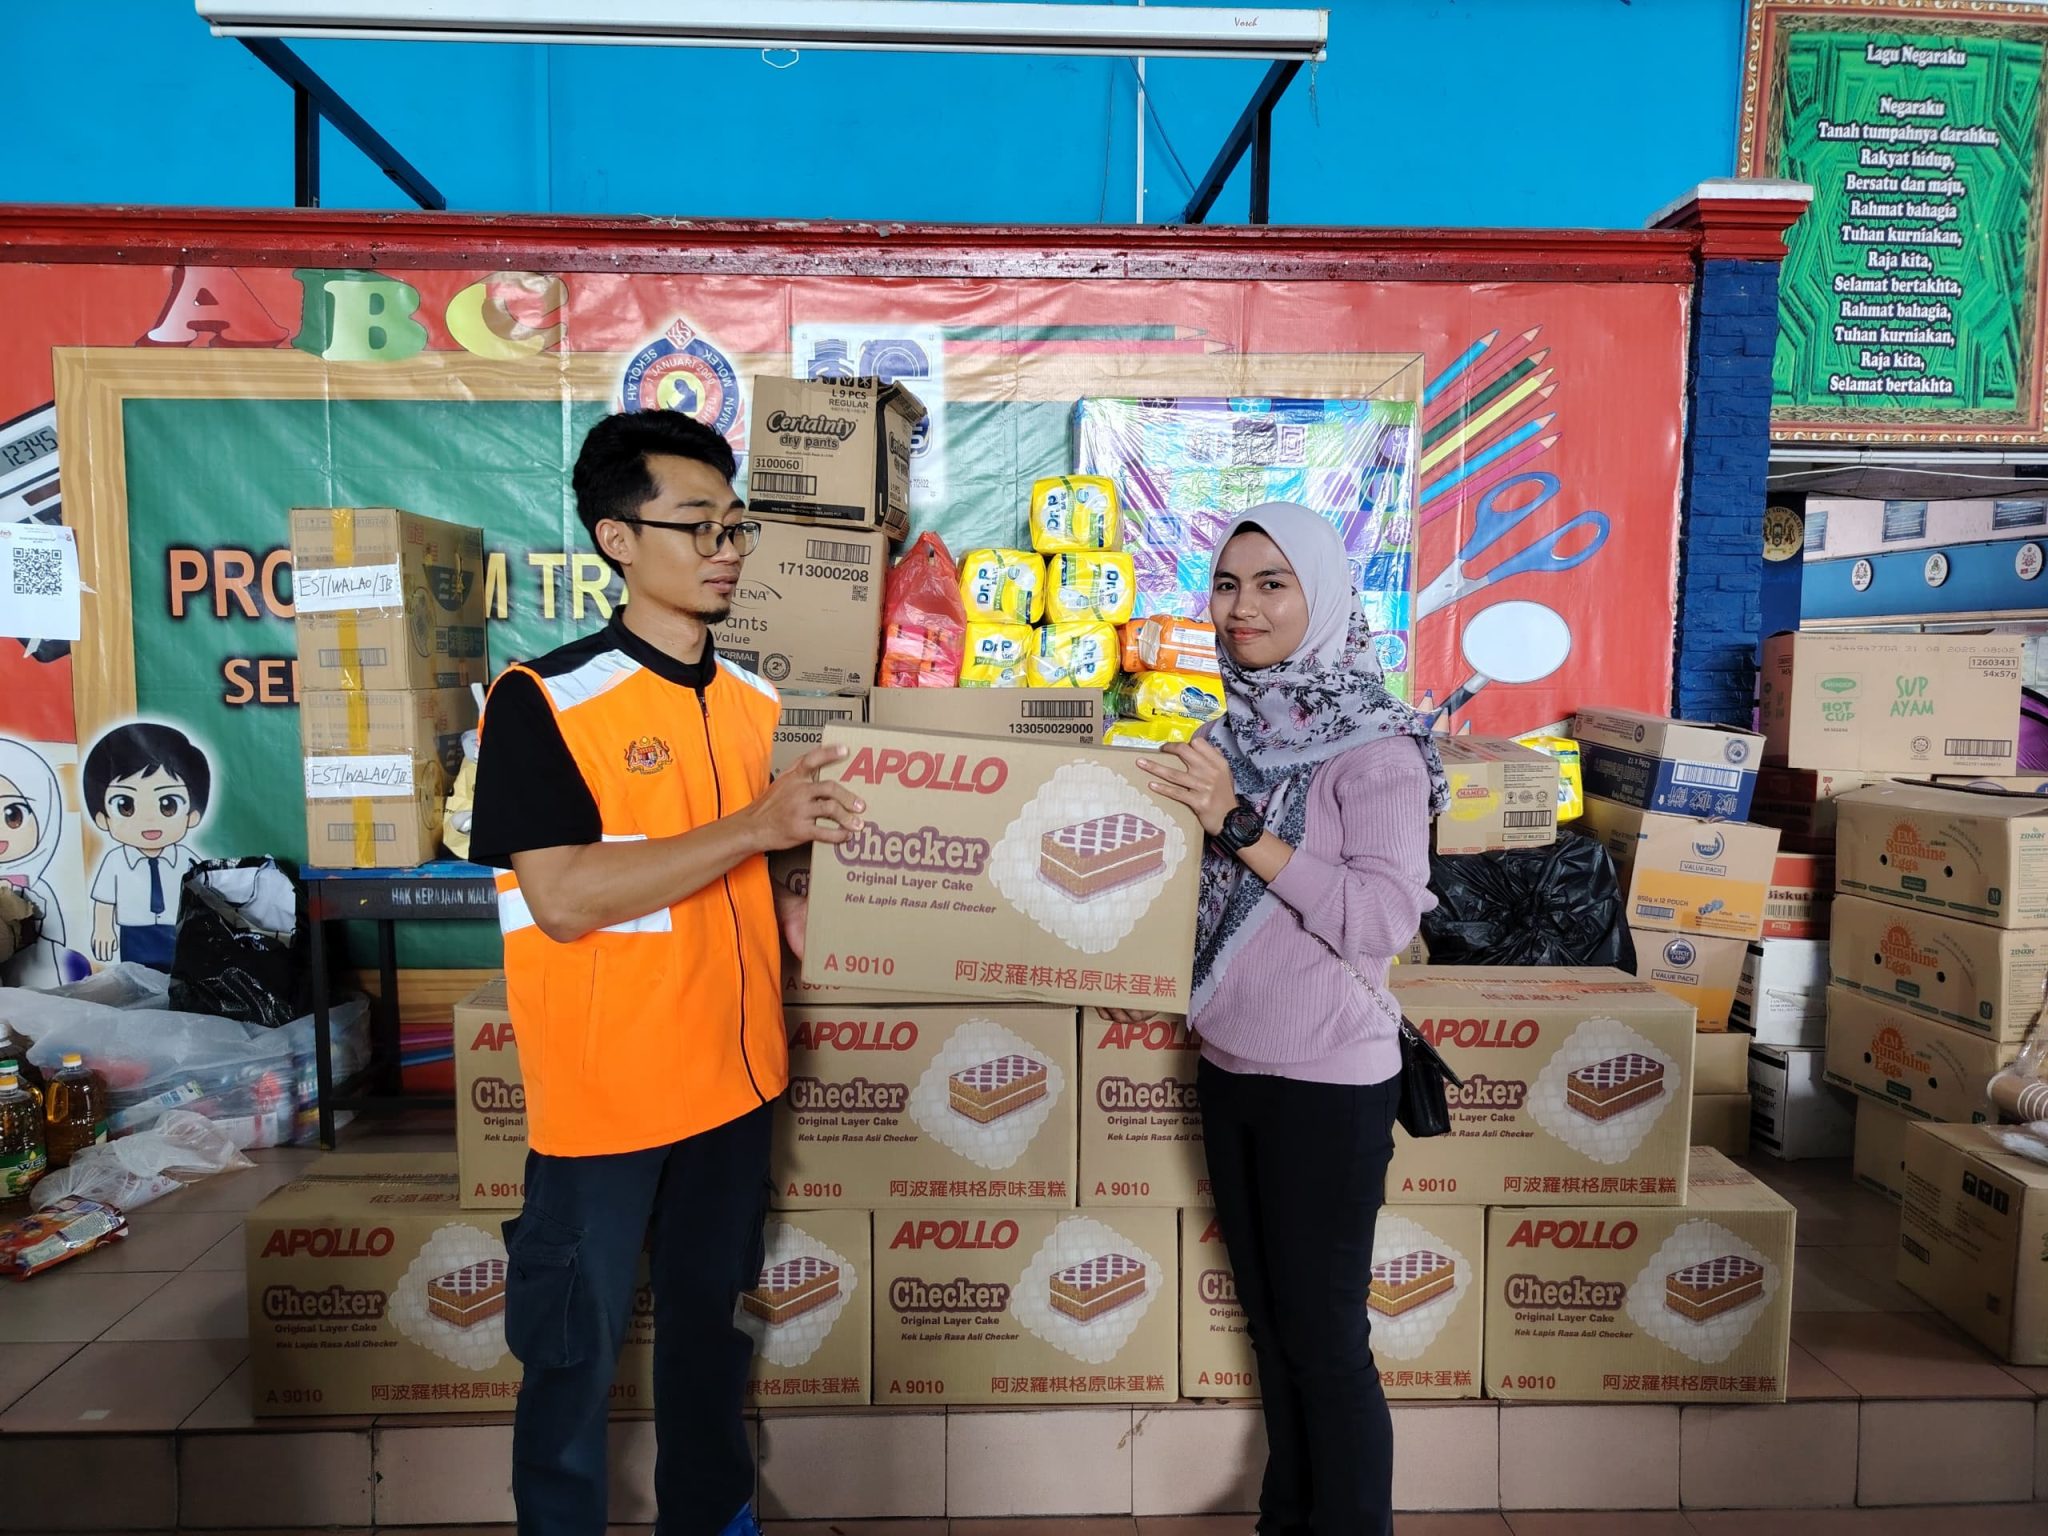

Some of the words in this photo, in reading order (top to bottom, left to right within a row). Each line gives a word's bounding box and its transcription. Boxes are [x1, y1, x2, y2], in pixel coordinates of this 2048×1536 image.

[1867, 45, 1899, 65] Lagu
[1902, 46, 1966, 67] Negaraku
[1880, 98, 1945, 118] Negaraku
[1818, 121, 1860, 138] Tanah
[1863, 125, 1937, 144] tumpahnya
[1940, 128, 1999, 147] darahku,
[1860, 149, 1910, 168] Rakyat
[1912, 151, 1955, 170] hidup,
[1847, 174, 1897, 191] Bersatu
[1900, 176, 1926, 191] dan
[1928, 178, 1966, 196] maju,
[1851, 200, 1904, 217] Rahmat
[1906, 201, 1957, 220] bahagia
[1842, 225, 1884, 241] Tuhan
[1887, 227, 1962, 246] kurniakan,
[1868, 251, 1898, 270] Raja
[1901, 252, 1932, 271] kita,
[1834, 276, 1889, 292] Selamat
[1891, 277, 1962, 297] bertakhta,
[1841, 302, 1894, 317] Rahmat
[1897, 303, 1951, 321] bahagia,
[1834, 326, 1877, 342] Tuhan
[1880, 328, 1955, 346] kurniakan,
[703, 349, 733, 388] MOLEK
[1861, 352, 1890, 371] Raja
[1893, 353, 1925, 371] kita,
[627, 349, 657, 401] SEKOLAH
[651, 358, 696, 377] JANUARI
[697, 364, 716, 385] 2000
[1829, 376, 1884, 392] Selamat
[1886, 377, 1953, 393] bertakhta
[829, 399, 869, 409] REGULAR
[840, 390, 846, 399] 9
[848, 390, 867, 400] PCS
[767, 410, 856, 442] Certainty
[0, 430, 58, 467] 12345
[780, 433, 801, 449] dry
[804, 436, 839, 450] pants
[755, 458, 800, 470] 3100060
[778, 561, 869, 582] 1713000208
[714, 616, 768, 632] ants
[715, 632, 751, 644] Value
[1947, 646, 1976, 654] 2025
[1972, 659, 2016, 668] 12603431
[1983, 670, 2017, 679] 54x57g
[1896, 675, 1929, 699] SUP
[1822, 702, 1852, 712] HOT
[1890, 700, 1934, 717] AYAM
[1825, 712, 1855, 721] CUP
[1009, 722, 1093, 734] 133050029000
[840, 747, 1008, 794] APOLLO
[837, 824, 987, 873] Checker
[1886, 838, 1946, 861] Sunshine
[1683, 864, 1703, 872] VALUE
[1891, 856, 1919, 873] Eggs
[847, 871, 897, 886] Original
[902, 875, 937, 890] Layer
[941, 878, 973, 892] Cake
[845, 893, 865, 904] Kek
[868, 895, 897, 907] Lapis
[900, 897, 927, 909] Rasa
[930, 900, 950, 910] Asli
[952, 903, 997, 914] Checker
[1880, 939, 1938, 969] Sunshine
[824, 954, 838, 971] A
[845, 955, 895, 976] 9010
[1885, 957, 1911, 976] Eggs
[955, 959, 1177, 998] 阿波羅棋格原味蛋糕
[1655, 972, 1675, 981] VALUE
[1677, 974, 1694, 982] PACK
[789, 1021, 918, 1051] APOLLO
[1872, 1039, 1930, 1074] Sunshine
[790, 1079, 907, 1112] Checker
[484, 1117, 523, 1127] Original
[798, 1117, 839, 1127] Original
[841, 1117, 871, 1127] Layer
[873, 1117, 898, 1126] Cake
[1107, 1117, 1147, 1127] Original
[1150, 1117, 1179, 1127] Layer
[1459, 1113, 1487, 1123] Layer
[1490, 1113, 1515, 1122] Cake
[817, 1134, 840, 1143] Lapis
[842, 1134, 864, 1142] Rasa
[883, 1134, 918, 1142] Checker
[1126, 1133, 1148, 1142] Lapis
[1151, 1133, 1172, 1141] Rasa
[1459, 1129, 1481, 1138] Rasa
[1500, 1130, 1534, 1138] Checker
[787, 1183, 799, 1197] A
[803, 1183, 842, 1197] 9010
[890, 1180, 1067, 1198] 阿波羅棋格原味蛋糕
[1111, 1182, 1149, 1196] 9010
[1402, 1179, 1414, 1192] A
[1419, 1178, 1457, 1192] 9010
[1504, 1176, 1677, 1194] 阿波羅棋格原味蛋糕
[260, 1227, 395, 1258] APOLLO
[890, 1220, 1019, 1250] APOLLO
[1507, 1220, 1638, 1249] APOLLO
[891, 1279, 1008, 1311] Checker
[1507, 1276, 1624, 1308] Checker
[265, 1287, 387, 1318] Checker
[901, 1317, 940, 1326] Original
[943, 1317, 972, 1327] Layer
[974, 1317, 1000, 1325] Cake
[1515, 1313, 1555, 1323] Original
[1557, 1313, 1587, 1323] Layer
[1589, 1314, 1615, 1323] Cake
[275, 1324, 316, 1335] Original
[319, 1324, 349, 1334] Layer
[920, 1333, 942, 1342] Lapis
[945, 1333, 965, 1341] Rasa
[985, 1333, 1019, 1341] Checker
[1533, 1329, 1555, 1338] Lapis
[1558, 1329, 1579, 1338] Rasa
[1598, 1331, 1633, 1339] Checker
[907, 1380, 945, 1394] 9010
[991, 1375, 1165, 1393] 阿波羅棋格原味蛋糕
[1214, 1372, 1252, 1386] 9010
[1518, 1375, 1556, 1389] 9010
[1603, 1374, 1777, 1392] 阿波羅棋格原味蛋糕
[283, 1389, 322, 1403] 9010
